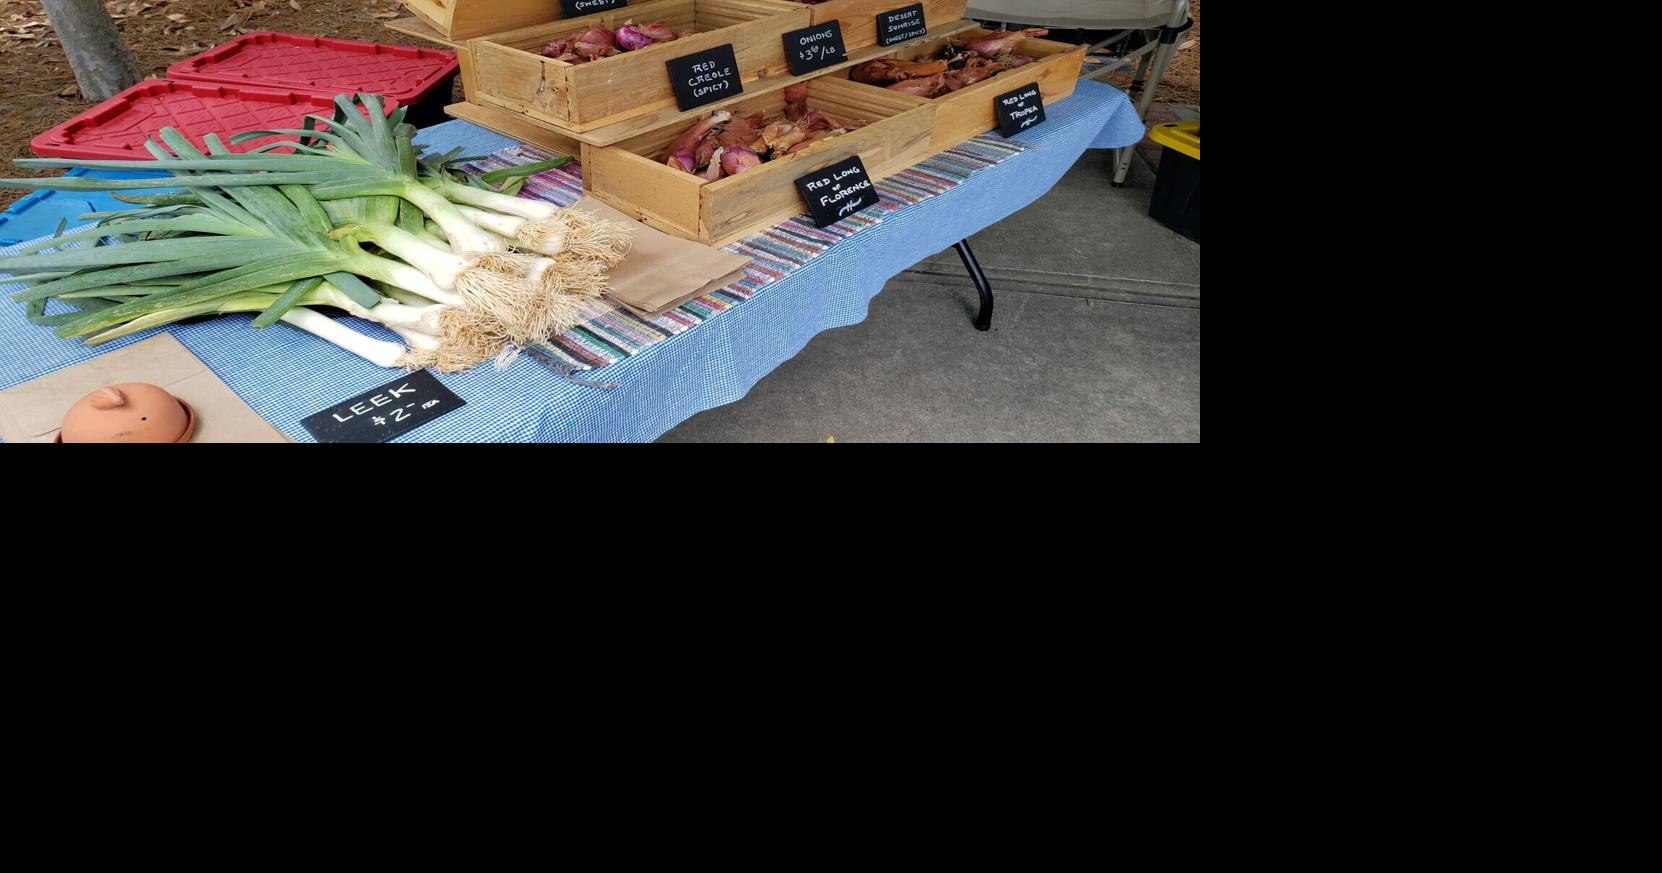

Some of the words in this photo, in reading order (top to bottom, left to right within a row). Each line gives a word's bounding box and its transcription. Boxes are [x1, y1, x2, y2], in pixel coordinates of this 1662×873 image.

[888, 10, 917, 23] DESERT
[888, 19, 920, 32] SUNRISE
[800, 29, 833, 45] ONIONS
[692, 61, 716, 73] RED
[688, 68, 731, 86] CREOLE
[693, 80, 729, 98] (SPICY)
[1002, 96, 1019, 105] RED
[1019, 90, 1037, 100] LONG
[1009, 105, 1038, 120] TROPEA
[806, 178, 830, 191] RED
[833, 166, 860, 181] LONG
[820, 180, 870, 207] FLORENCE
[332, 382, 416, 422] LEEK
